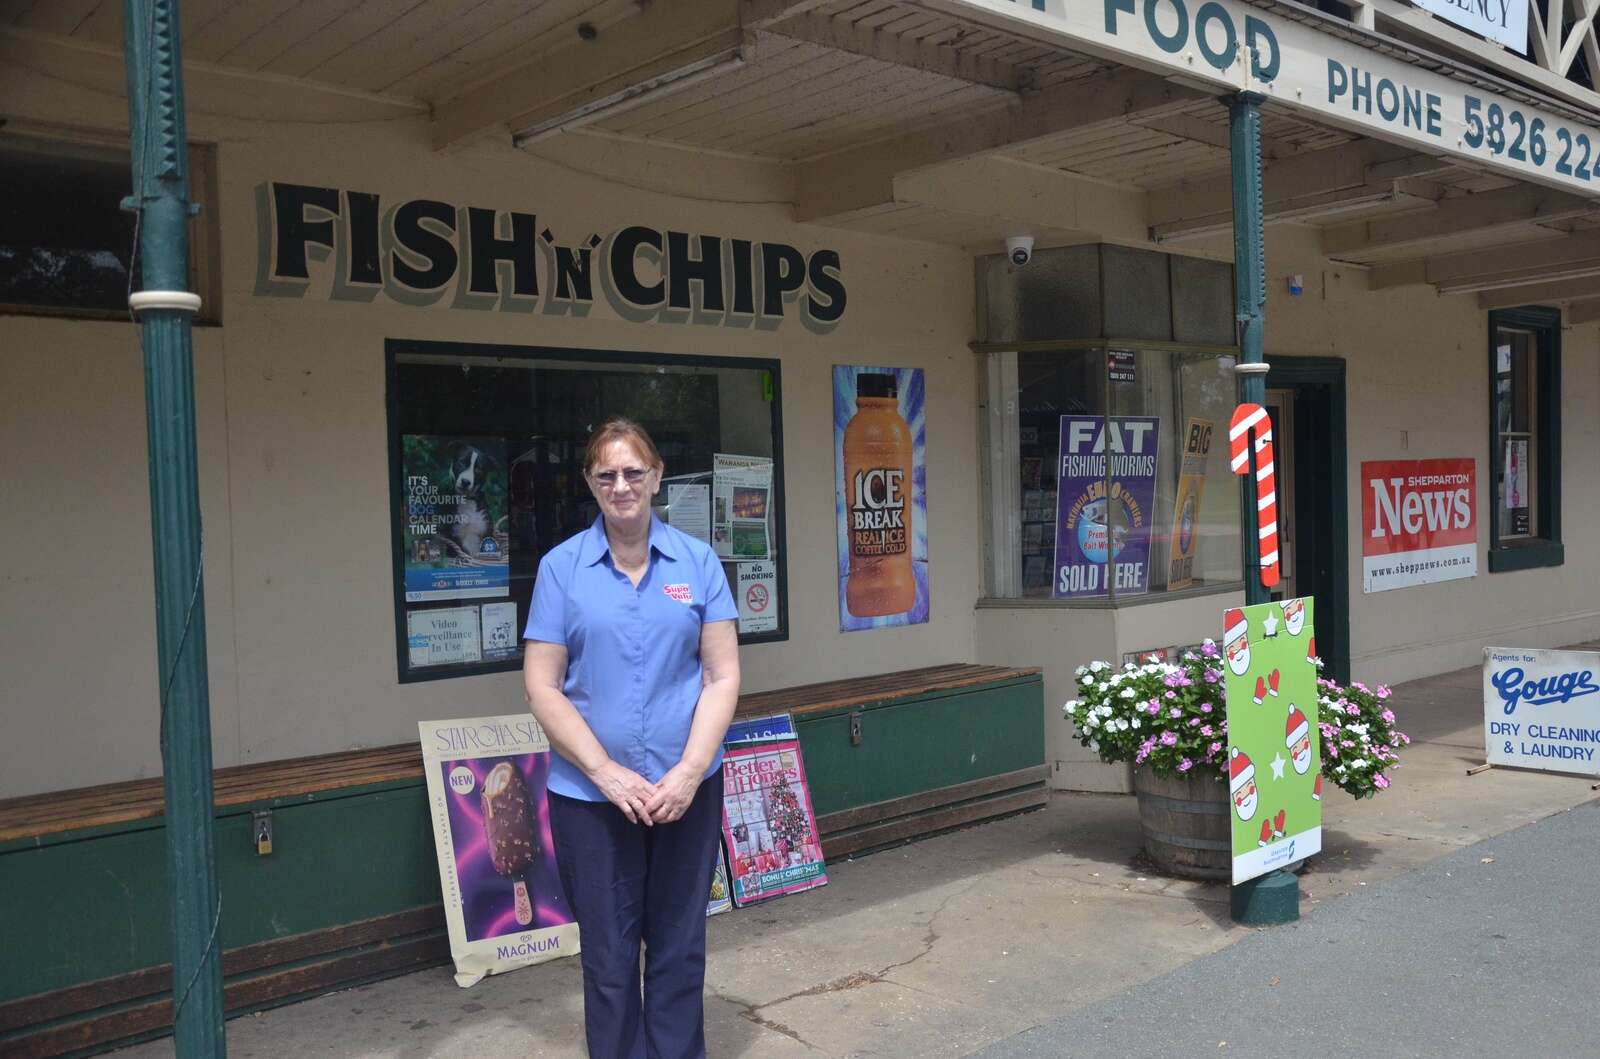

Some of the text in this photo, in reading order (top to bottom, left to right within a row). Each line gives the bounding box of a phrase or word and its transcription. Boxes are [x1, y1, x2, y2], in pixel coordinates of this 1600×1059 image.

[1327, 58, 1442, 137] PHONE
[1463, 94, 1547, 167] 5826
[268, 180, 540, 300] FISH
[608, 225, 848, 322] CHIPS
[1069, 421, 1153, 453] FAT
[1188, 423, 1212, 454] BIG
[1062, 455, 1154, 477] FISHING WORMS
[408, 475, 428, 486] IT'S
[1408, 473, 1470, 487] SHEPPARTON
[409, 485, 438, 496] YOUR
[853, 470, 904, 509] ICE
[408, 495, 467, 505] FAVOURITE
[1370, 477, 1471, 538] News
[853, 510, 904, 530] BREAK
[408, 524, 437, 535] TIME
[855, 529, 905, 545] REAL ICE
[885, 542, 906, 554] COLD
[740, 572, 774, 581] SMOKING
[751, 565, 763, 573] NO
[1060, 564, 1099, 592] SOLD
[431, 619, 458, 630] Video
[1492, 653, 1520, 663] Agents
[1491, 667, 1600, 715] Gouge
[1490, 722, 1521, 736] DRY
[1504, 741, 1595, 761] & LAUNDRY
[723, 759, 776, 778] Better
[450, 774, 474, 787] NEW
[497, 935, 560, 960] MAGNUM
